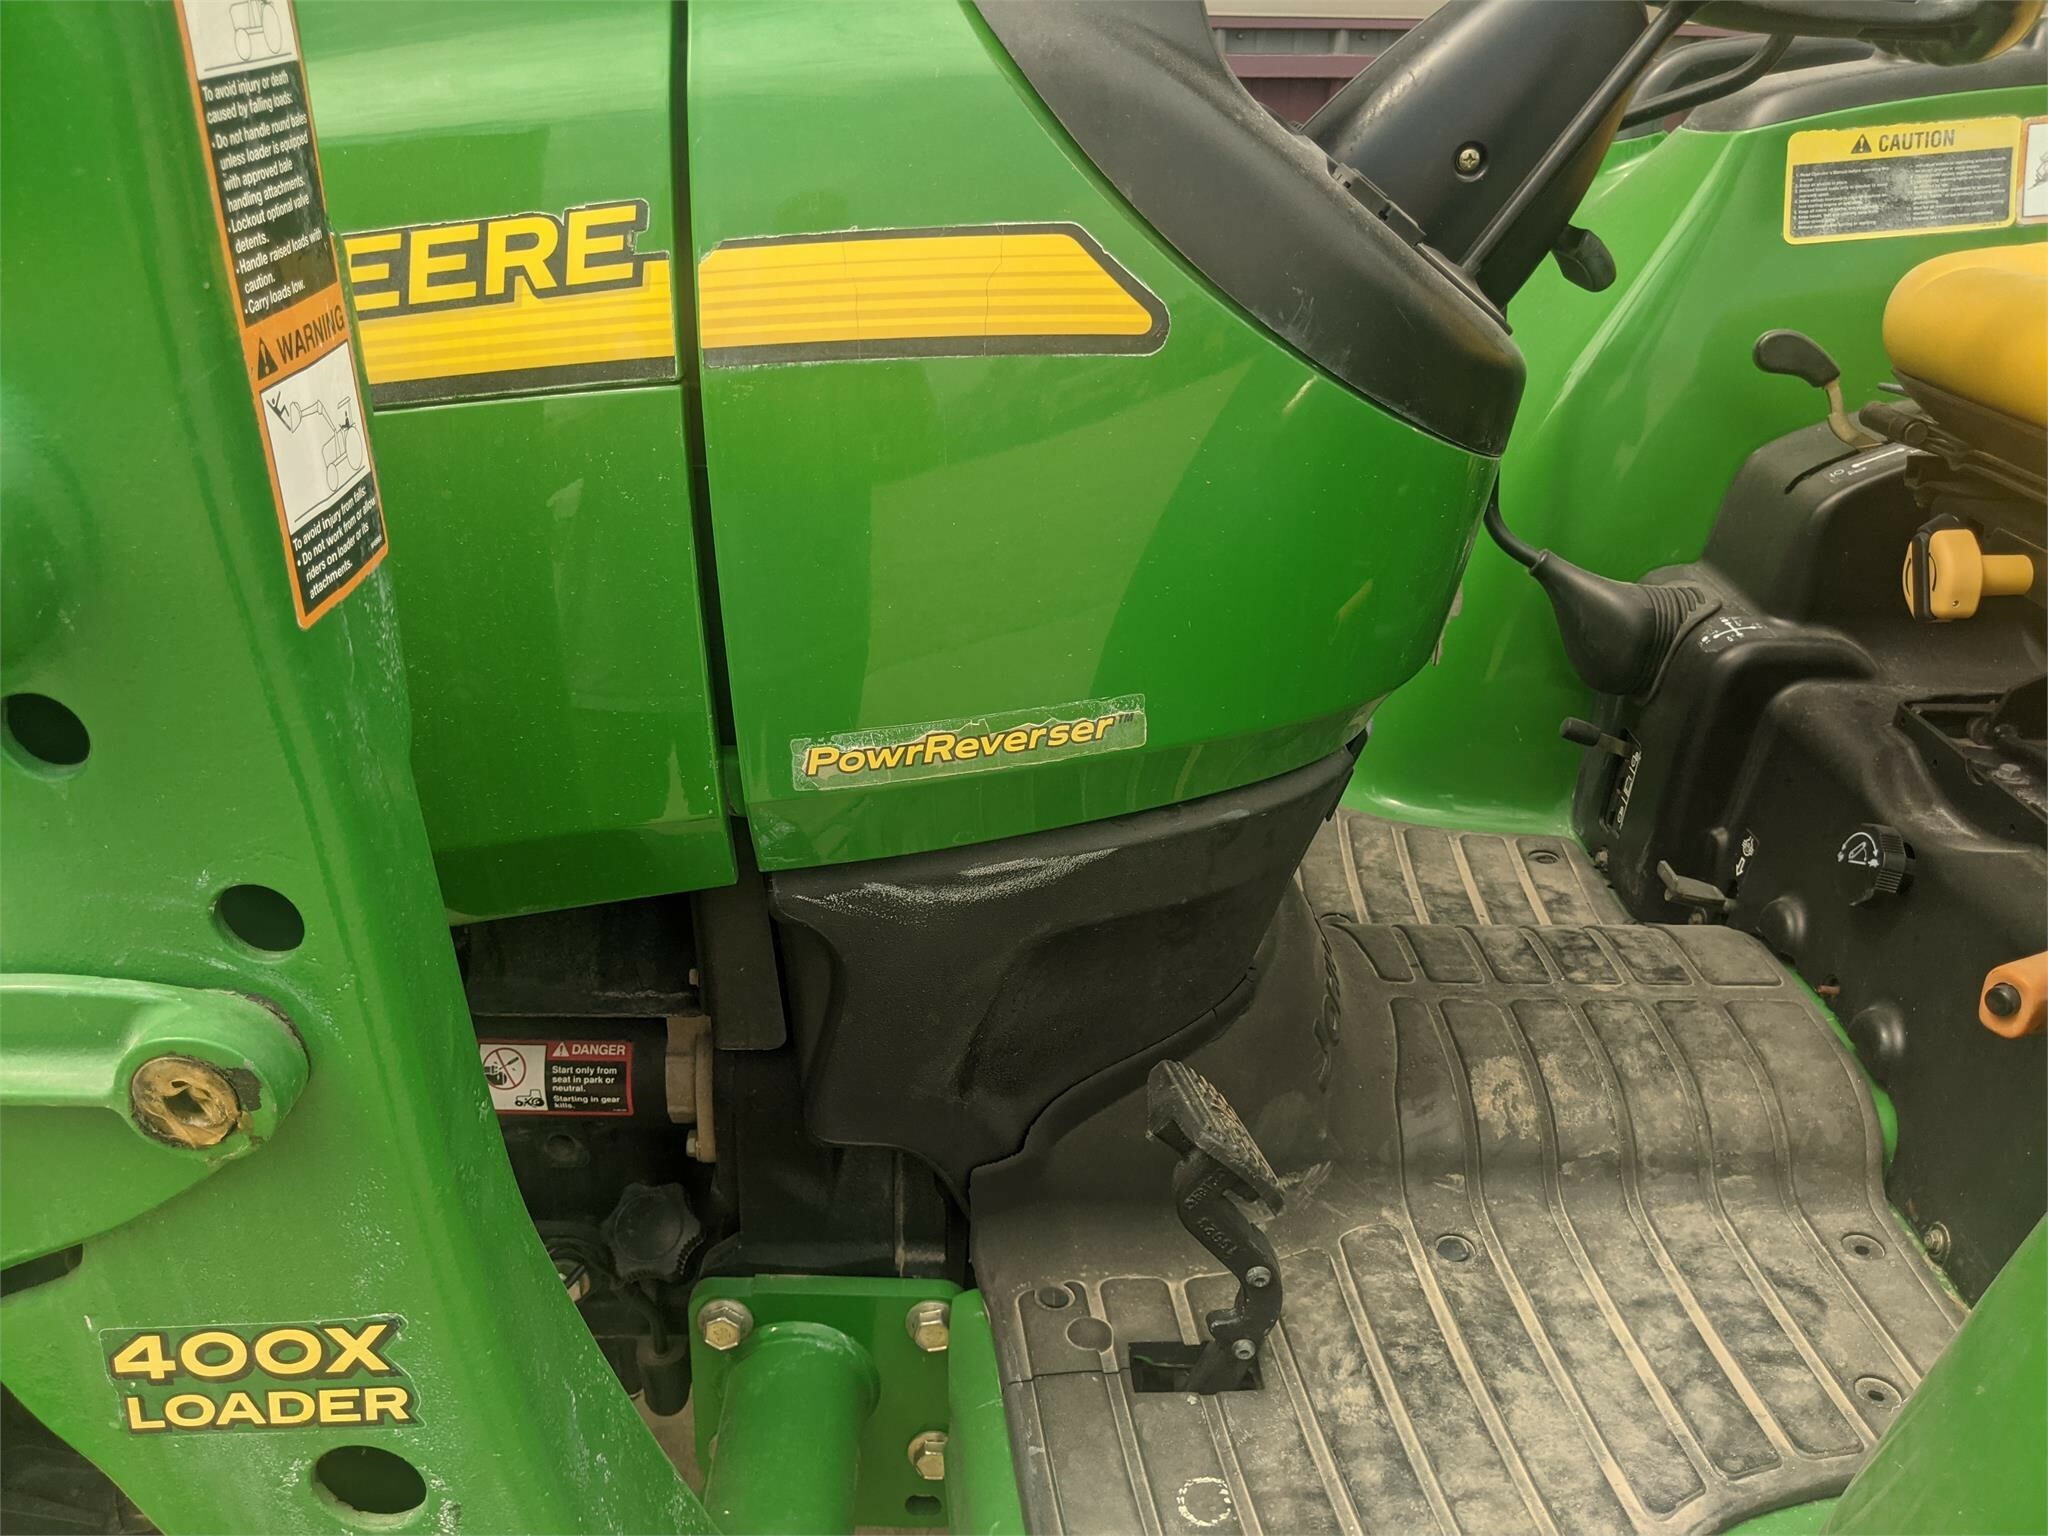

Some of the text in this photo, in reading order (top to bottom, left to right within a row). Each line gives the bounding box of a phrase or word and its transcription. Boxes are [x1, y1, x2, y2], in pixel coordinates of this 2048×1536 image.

[202, 70, 289, 102] To avoid injury or death
[206, 102, 237, 124] caused
[237, 99, 248, 119] by
[249, 96, 273, 114] falling
[229, 130, 243, 144] not
[243, 122, 270, 141] handle
[271, 118, 290, 135] round
[291, 113, 308, 128] bales
[1878, 129, 1955, 152] CAUTION
[220, 132, 309, 170] unless loader is equipped
[224, 174, 242, 191] with
[242, 165, 279, 187] approved
[227, 191, 263, 213] handling
[267, 199, 294, 221] optional
[293, 194, 310, 208] valve
[235, 232, 270, 254] detents.
[269, 243, 292, 261] raised
[292, 235, 309, 251] loads
[310, 227, 323, 244] with
[244, 272, 276, 294] caution.
[270, 285, 291, 304] loads
[291, 279, 306, 294] low.
[276, 305, 345, 364] WARNING
[293, 538, 302, 552] To
[303, 524, 321, 546] avoid
[322, 511, 342, 529] injury
[341, 497, 355, 516] from
[313, 543, 326, 556] not
[326, 529, 344, 547] work
[343, 517, 357, 534] from
[356, 512, 363, 524] or
[306, 560, 326, 583] riders
[327, 553, 338, 565] on
[338, 537, 356, 557] loader
[310, 560, 353, 600] attachments.
[571, 1044, 626, 1056] DANGER
[552, 1065, 617, 1077] Start only from
[552, 1076, 572, 1084] seat
[573, 1076, 582, 1084] in
[583, 1076, 603, 1085] park
[552, 1085, 586, 1093] neutral.
[553, 1095, 588, 1104] Starting
[112, 1323, 393, 1382] 400X
[125, 1386, 412, 1430] LOADER
